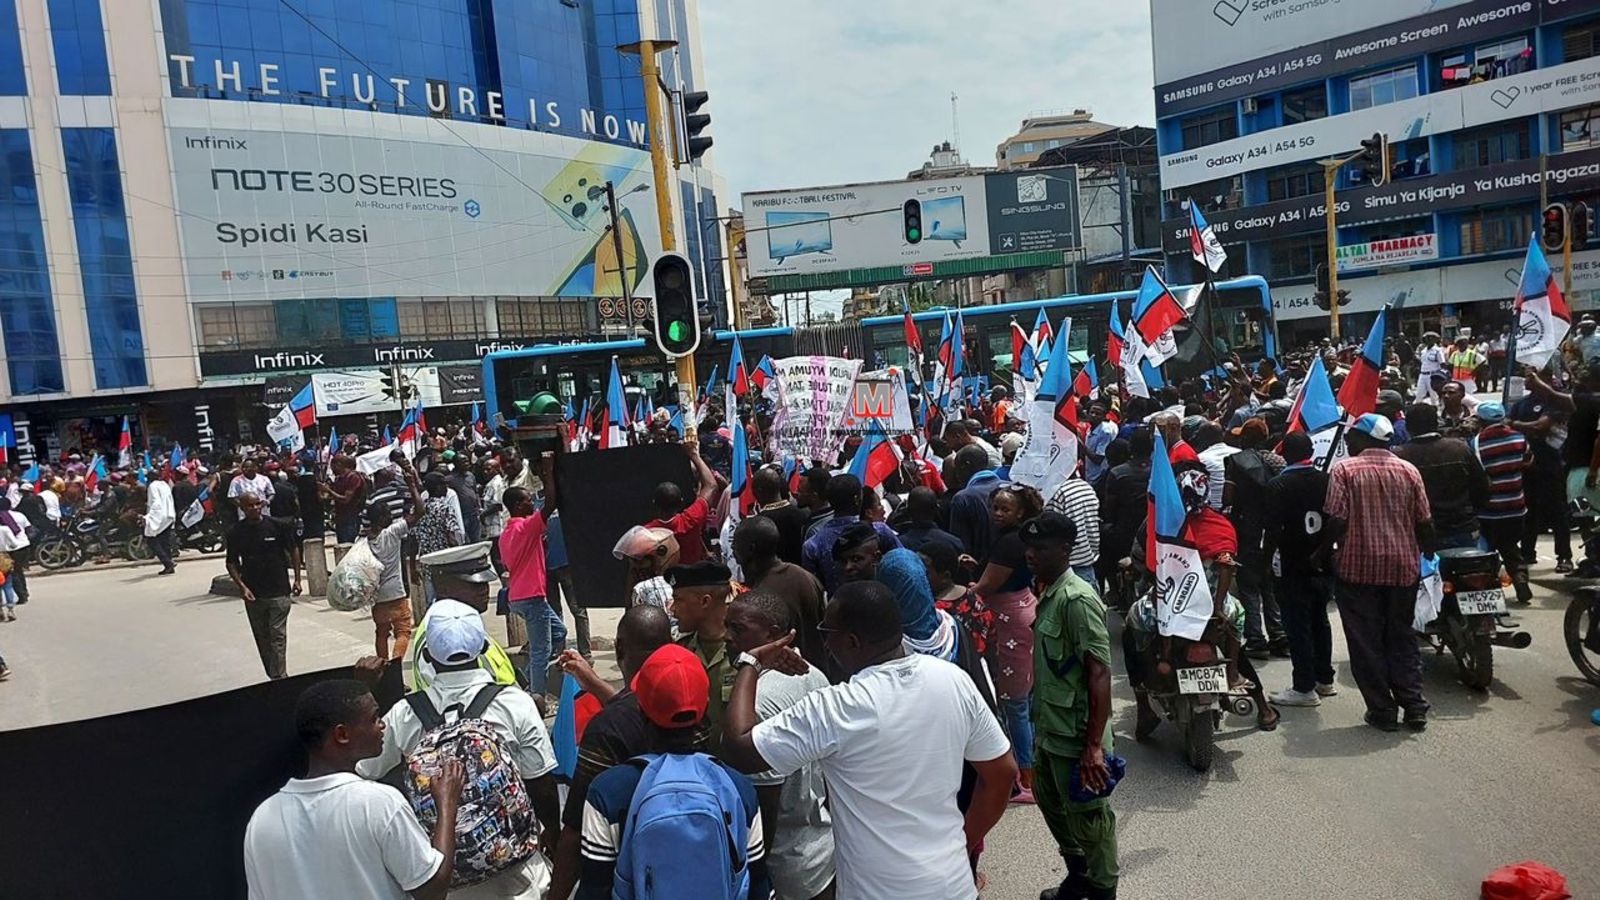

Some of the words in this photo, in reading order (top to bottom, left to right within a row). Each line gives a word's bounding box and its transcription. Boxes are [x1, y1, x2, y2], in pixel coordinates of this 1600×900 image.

[1263, 9, 1286, 22] with
[1163, 83, 1213, 104] SAMSUNG
[1217, 72, 1254, 90] Galaxy
[1256, 66, 1276, 80] A34
[1283, 60, 1304, 74] A54
[1306, 54, 1322, 66] 5G
[1334, 35, 1398, 61] Awesome
[1400, 22, 1448, 43] Screen
[1457, 1, 1532, 30] Awesome
[1530, 81, 1553, 95] year
[1555, 75, 1577, 87] FREE
[170, 54, 280, 95] THE
[319, 67, 503, 119] FUTURE
[529, 98, 561, 128] IS
[580, 107, 646, 145] NOW
[185, 136, 247, 151] Infinix
[1167, 153, 1198, 167] SAMSUNG
[1206, 151, 1245, 169] Galaxy
[1247, 145, 1267, 160] A34
[1275, 138, 1296, 153] A54
[1299, 135, 1315, 147] 5G
[951, 184, 962, 192] TV
[354, 200, 403, 211] All-Round
[406, 201, 459, 213] FastCharge
[752, 198, 781, 207] KARIBU
[822, 191, 856, 202] FESTIVAL
[1175, 222, 1229, 240] SANG
[1234, 214, 1276, 231] Galaxy
[1279, 208, 1300, 224] A34
[1334, 201, 1350, 214] 5G
[1364, 192, 1397, 209] Simu
[1399, 189, 1416, 203] Ya
[1419, 183, 1465, 202] Kijanja
[1474, 179, 1492, 192] Ya
[216, 222, 296, 248] Spidi
[306, 222, 368, 244] Kasi
[1371, 235, 1432, 254] PHARMACY
[1289, 298, 1309, 308] A54
[255, 352, 324, 369] Infinix
[375, 345, 434, 362] Infinix
[1197, 680, 1220, 692] DDW
